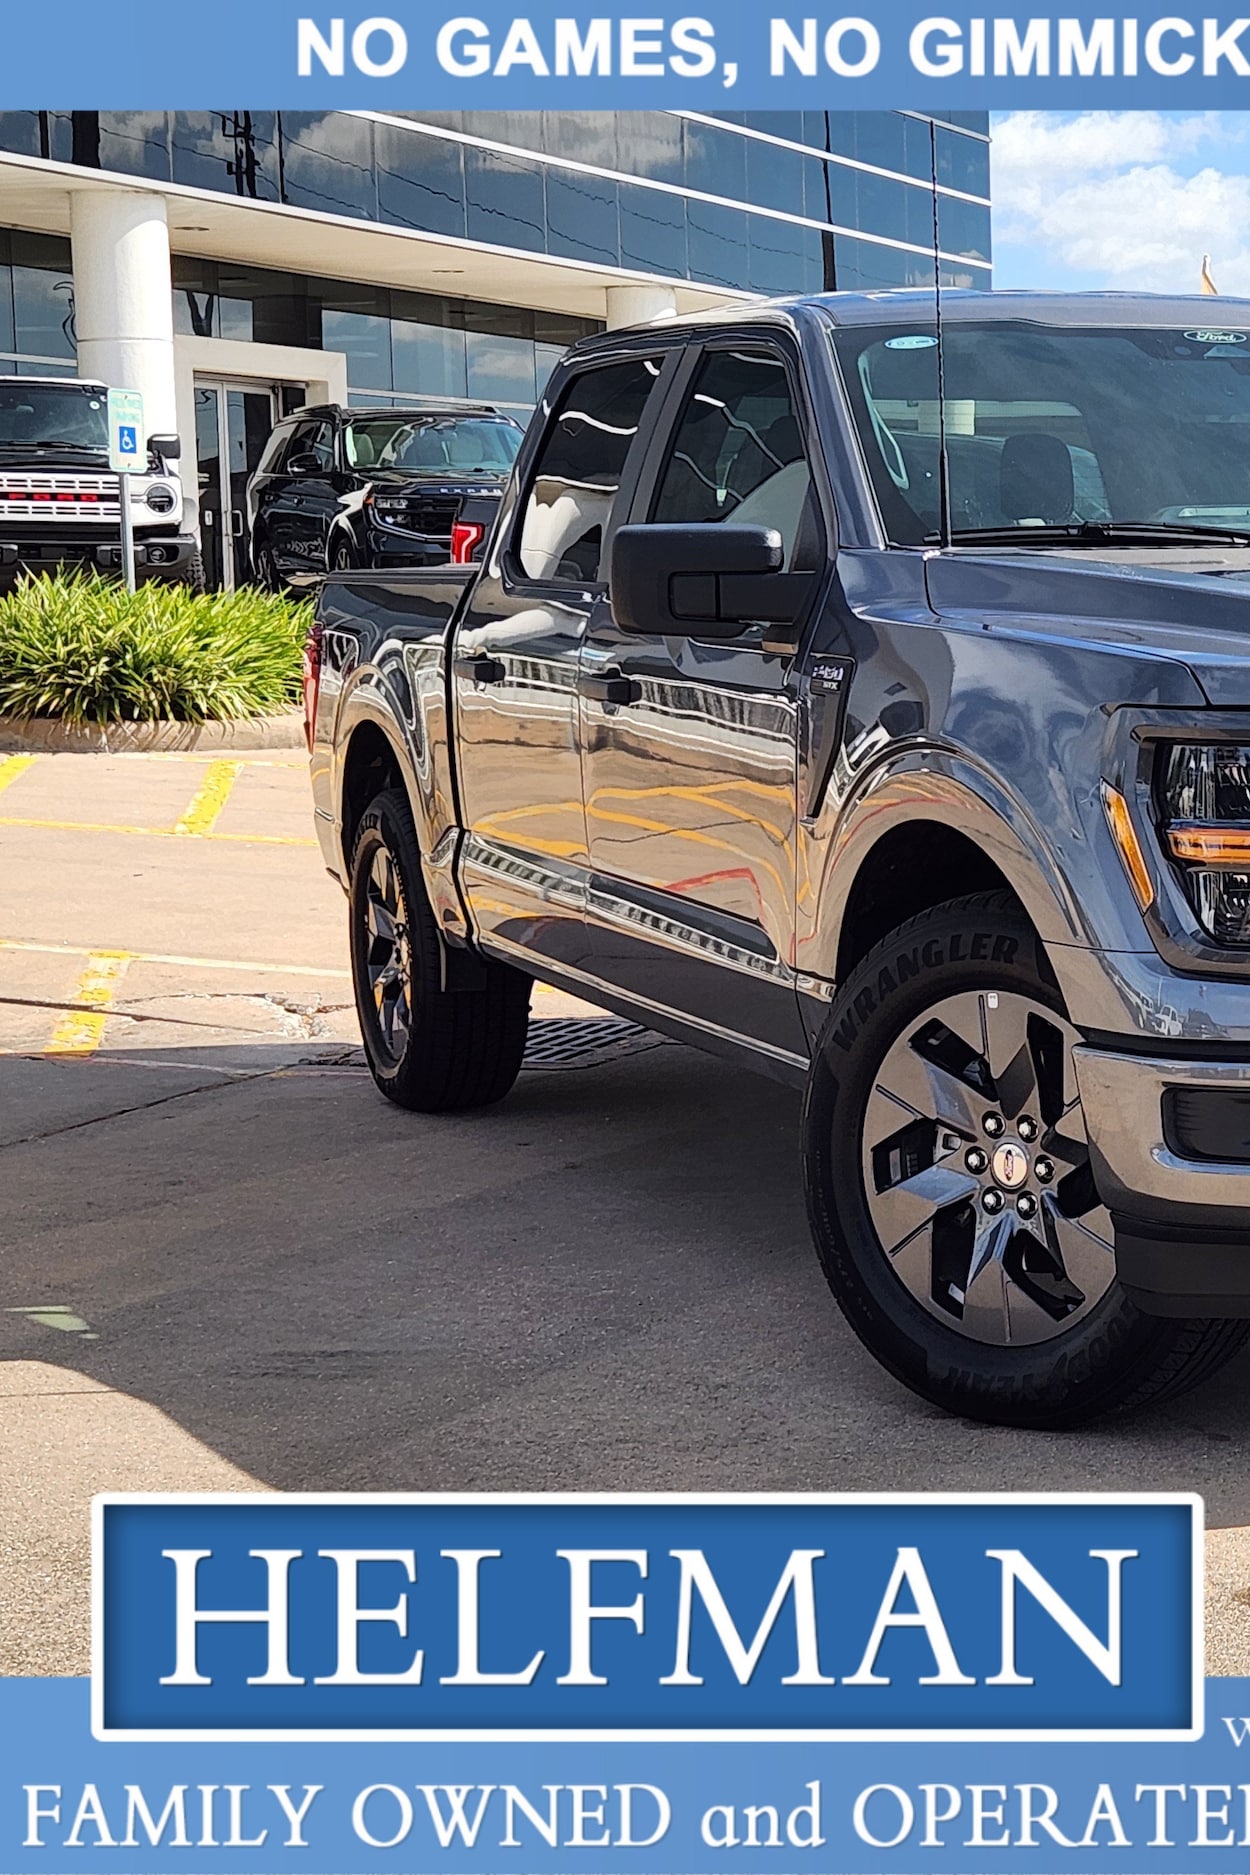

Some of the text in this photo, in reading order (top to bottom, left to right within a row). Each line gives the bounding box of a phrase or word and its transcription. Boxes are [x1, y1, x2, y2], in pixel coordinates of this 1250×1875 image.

[1197, 330, 1236, 342] Ford
[9, 493, 98, 501] FORD
[832, 932, 1020, 1052] WRANGLER
